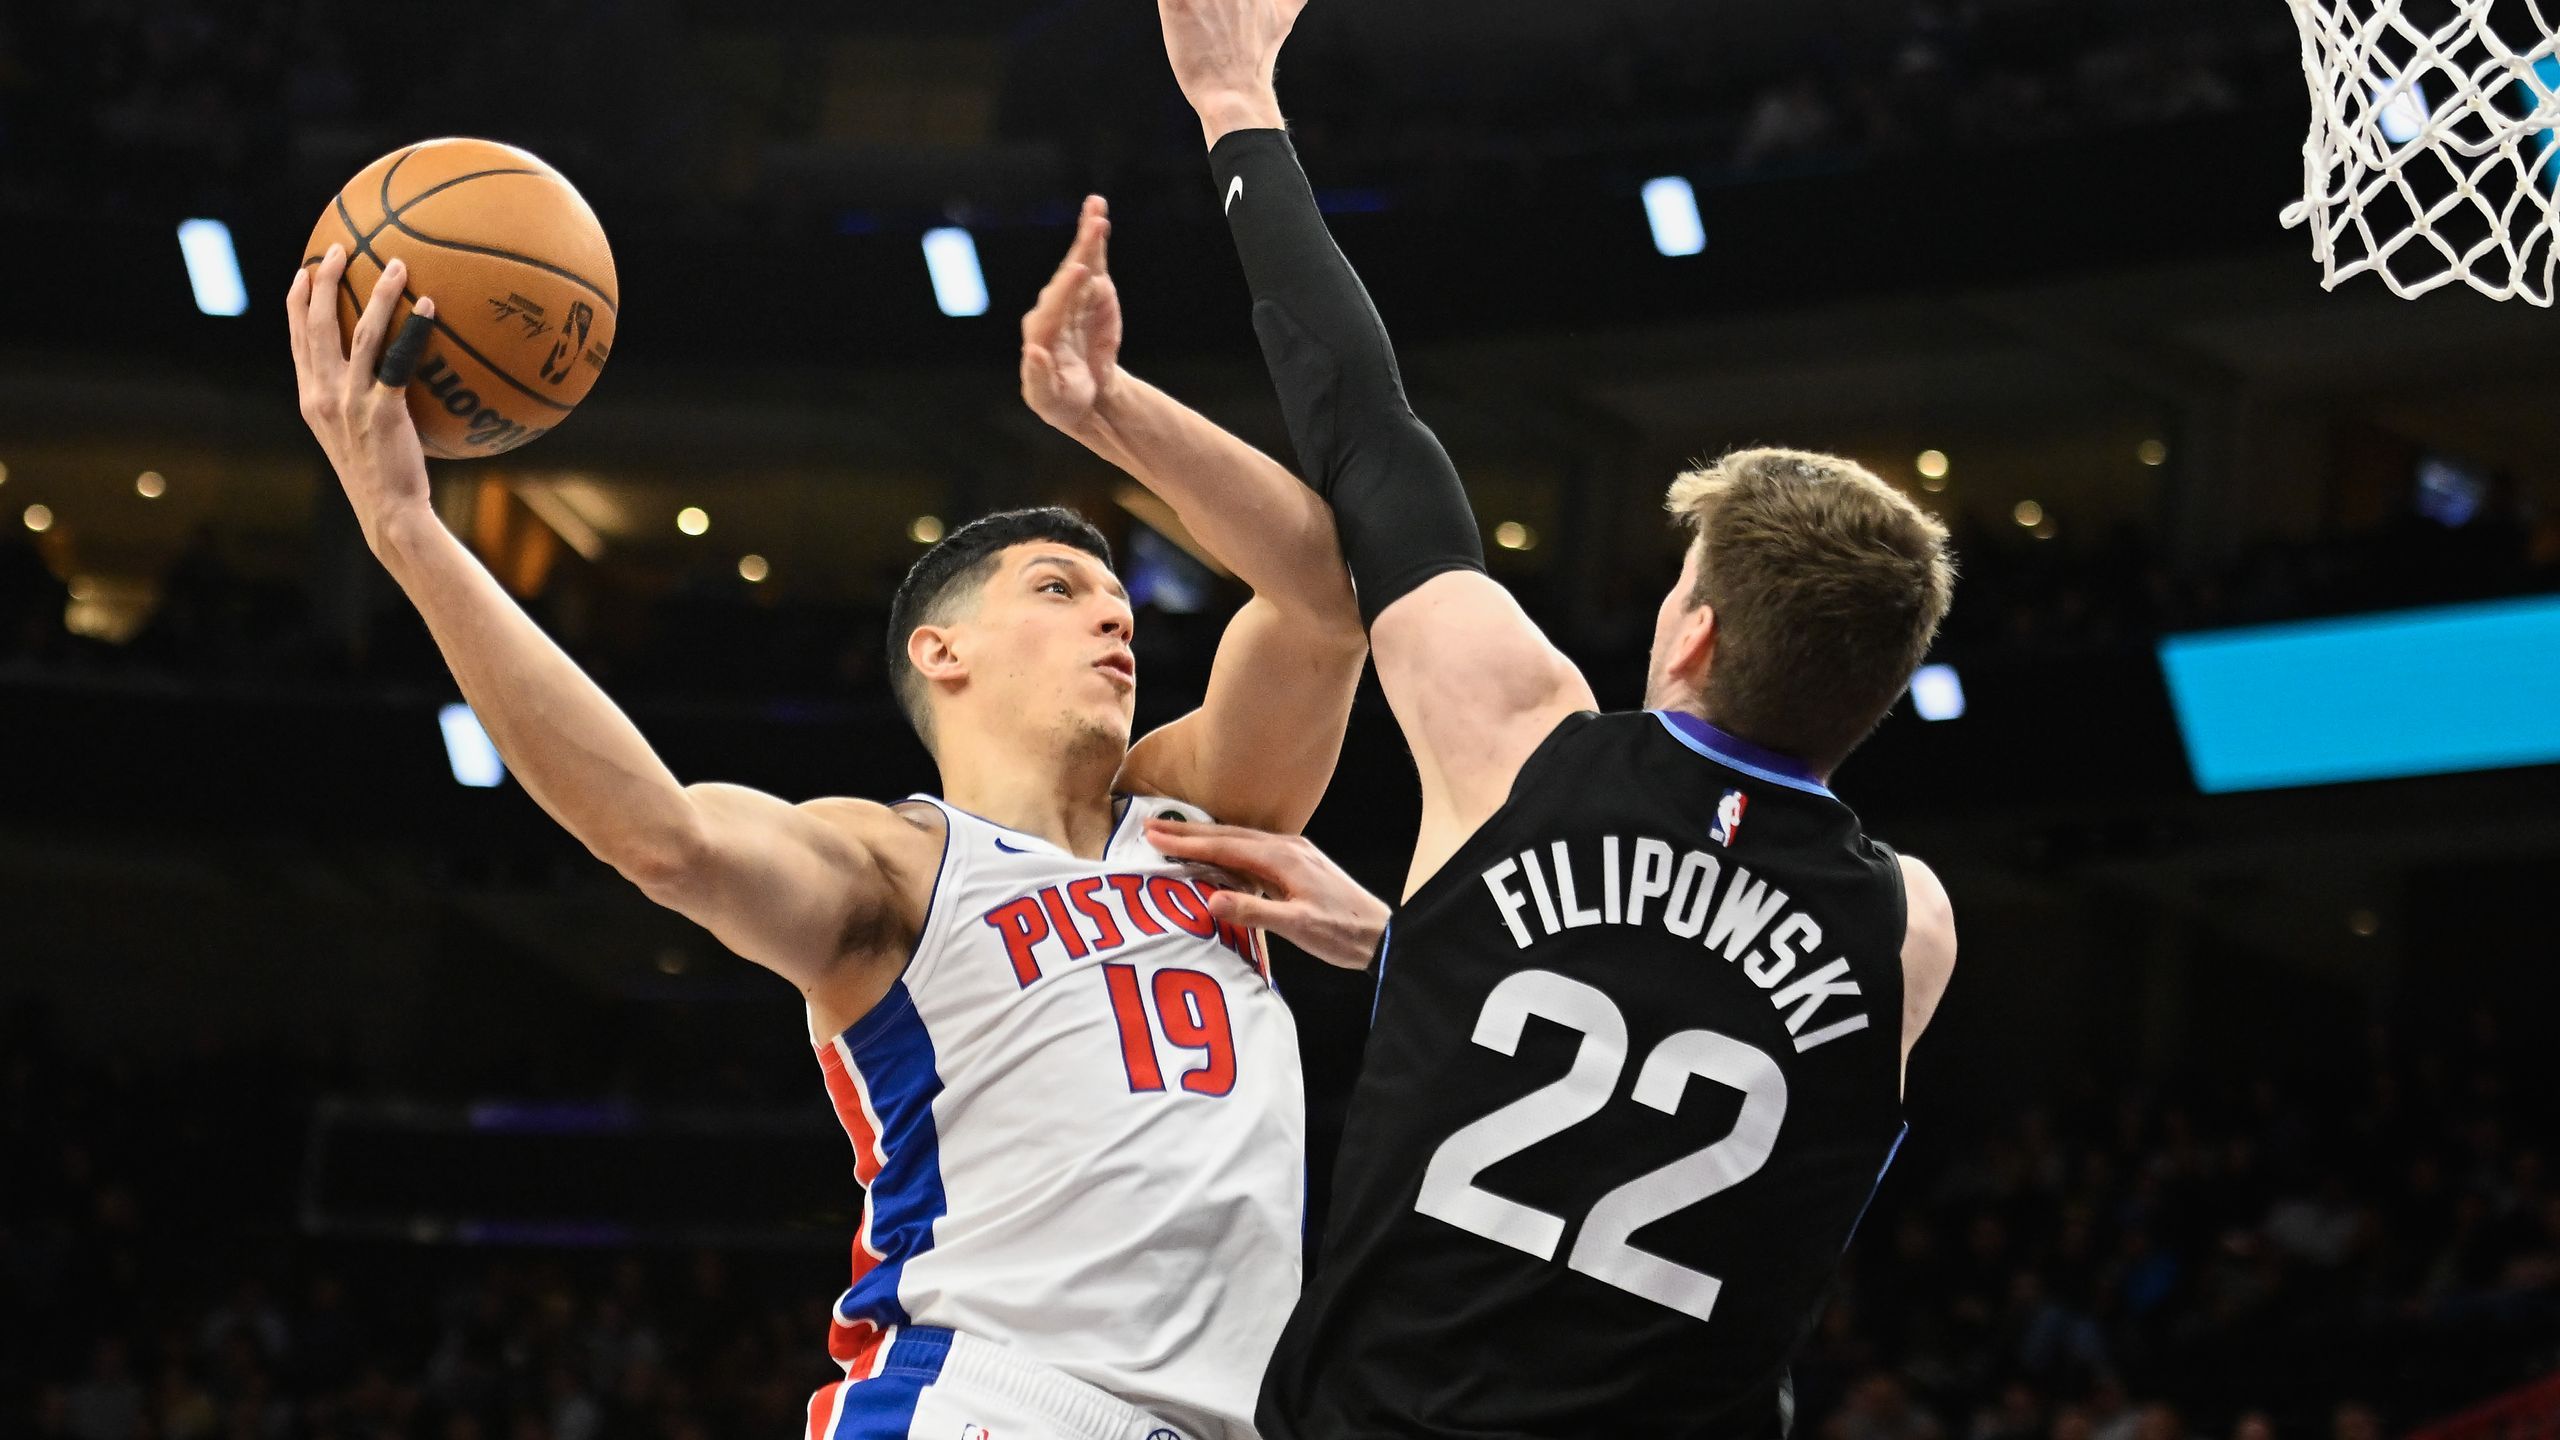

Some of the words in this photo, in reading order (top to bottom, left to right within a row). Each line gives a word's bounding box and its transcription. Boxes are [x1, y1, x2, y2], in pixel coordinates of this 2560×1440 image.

[1102, 963, 1237, 1098] 19
[1481, 835, 1869, 1054] FILIPOWSKI
[1414, 968, 1788, 1322] 22
